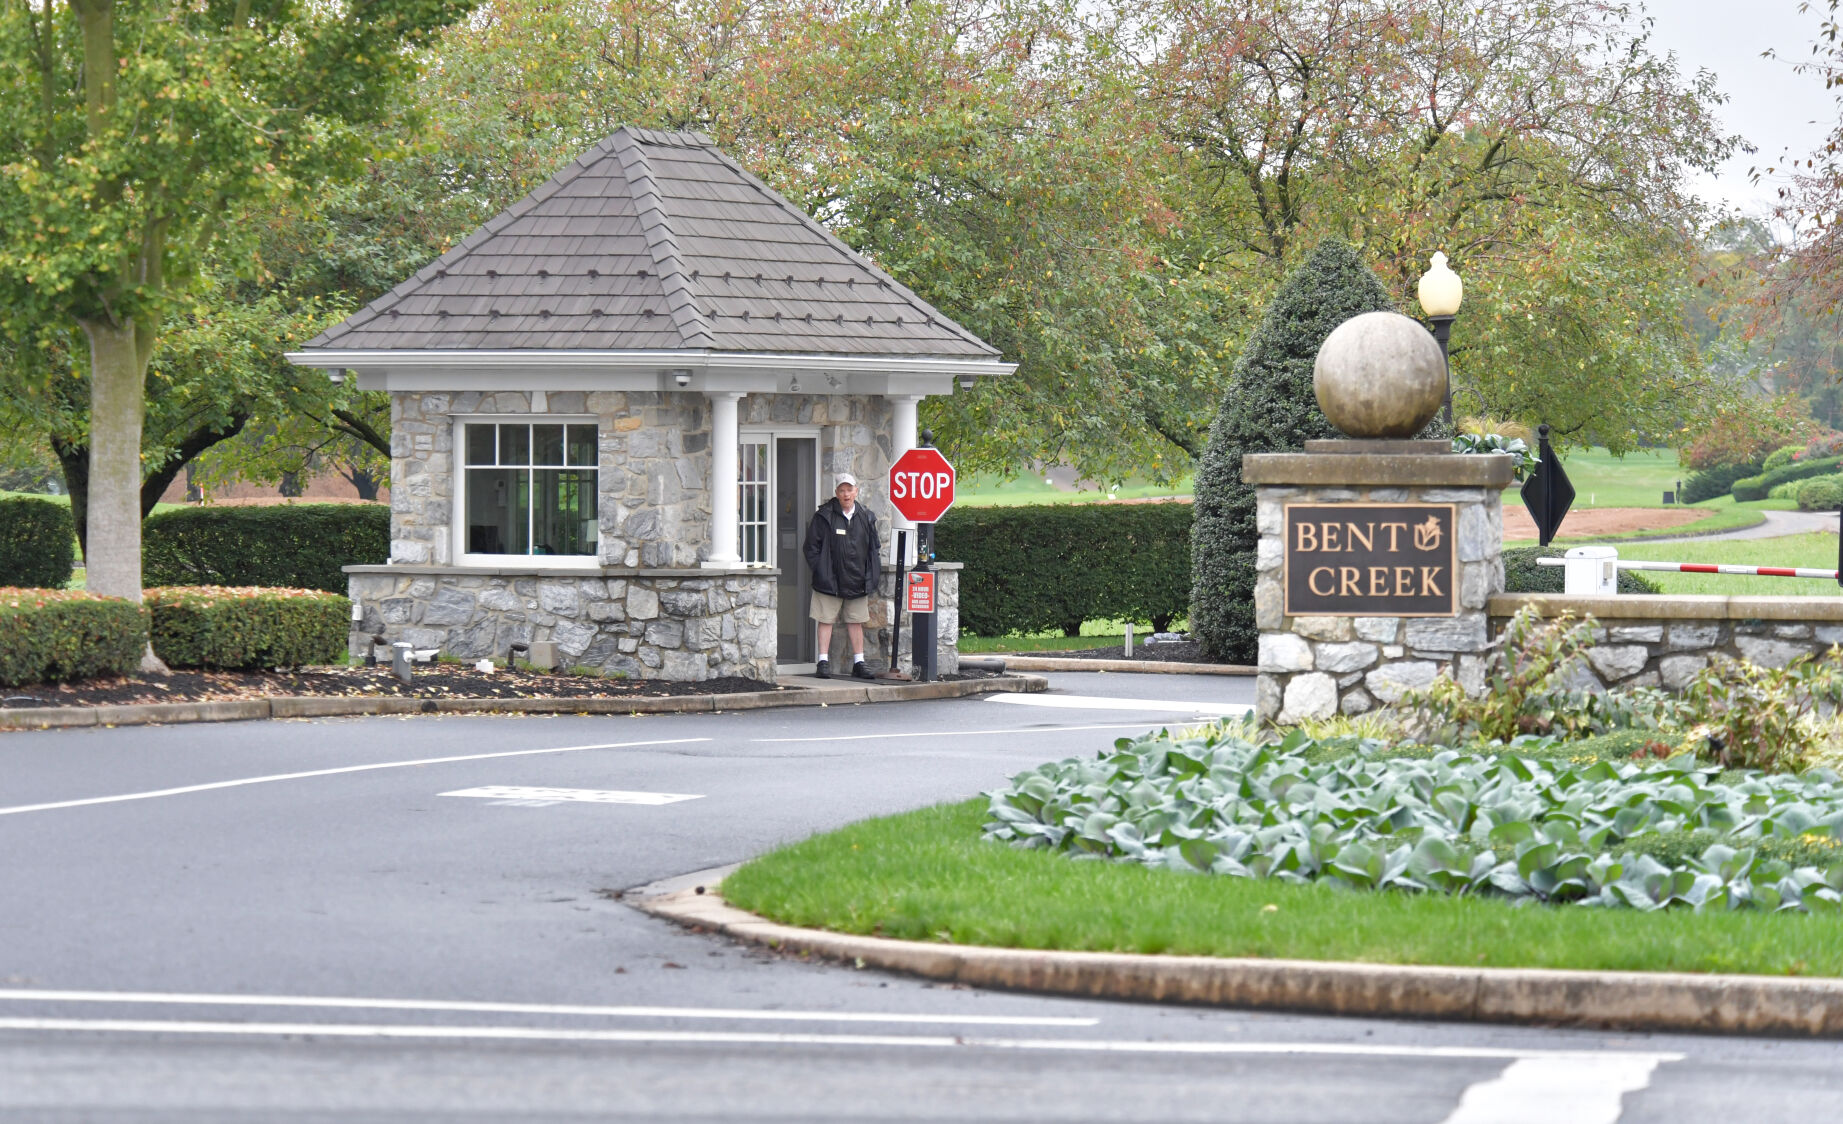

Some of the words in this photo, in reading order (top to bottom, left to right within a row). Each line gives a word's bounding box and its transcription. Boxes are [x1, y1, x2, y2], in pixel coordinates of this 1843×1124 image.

[893, 471, 951, 499] STOP
[1295, 522, 1408, 552] BENT
[1308, 566, 1444, 597] CREEK
